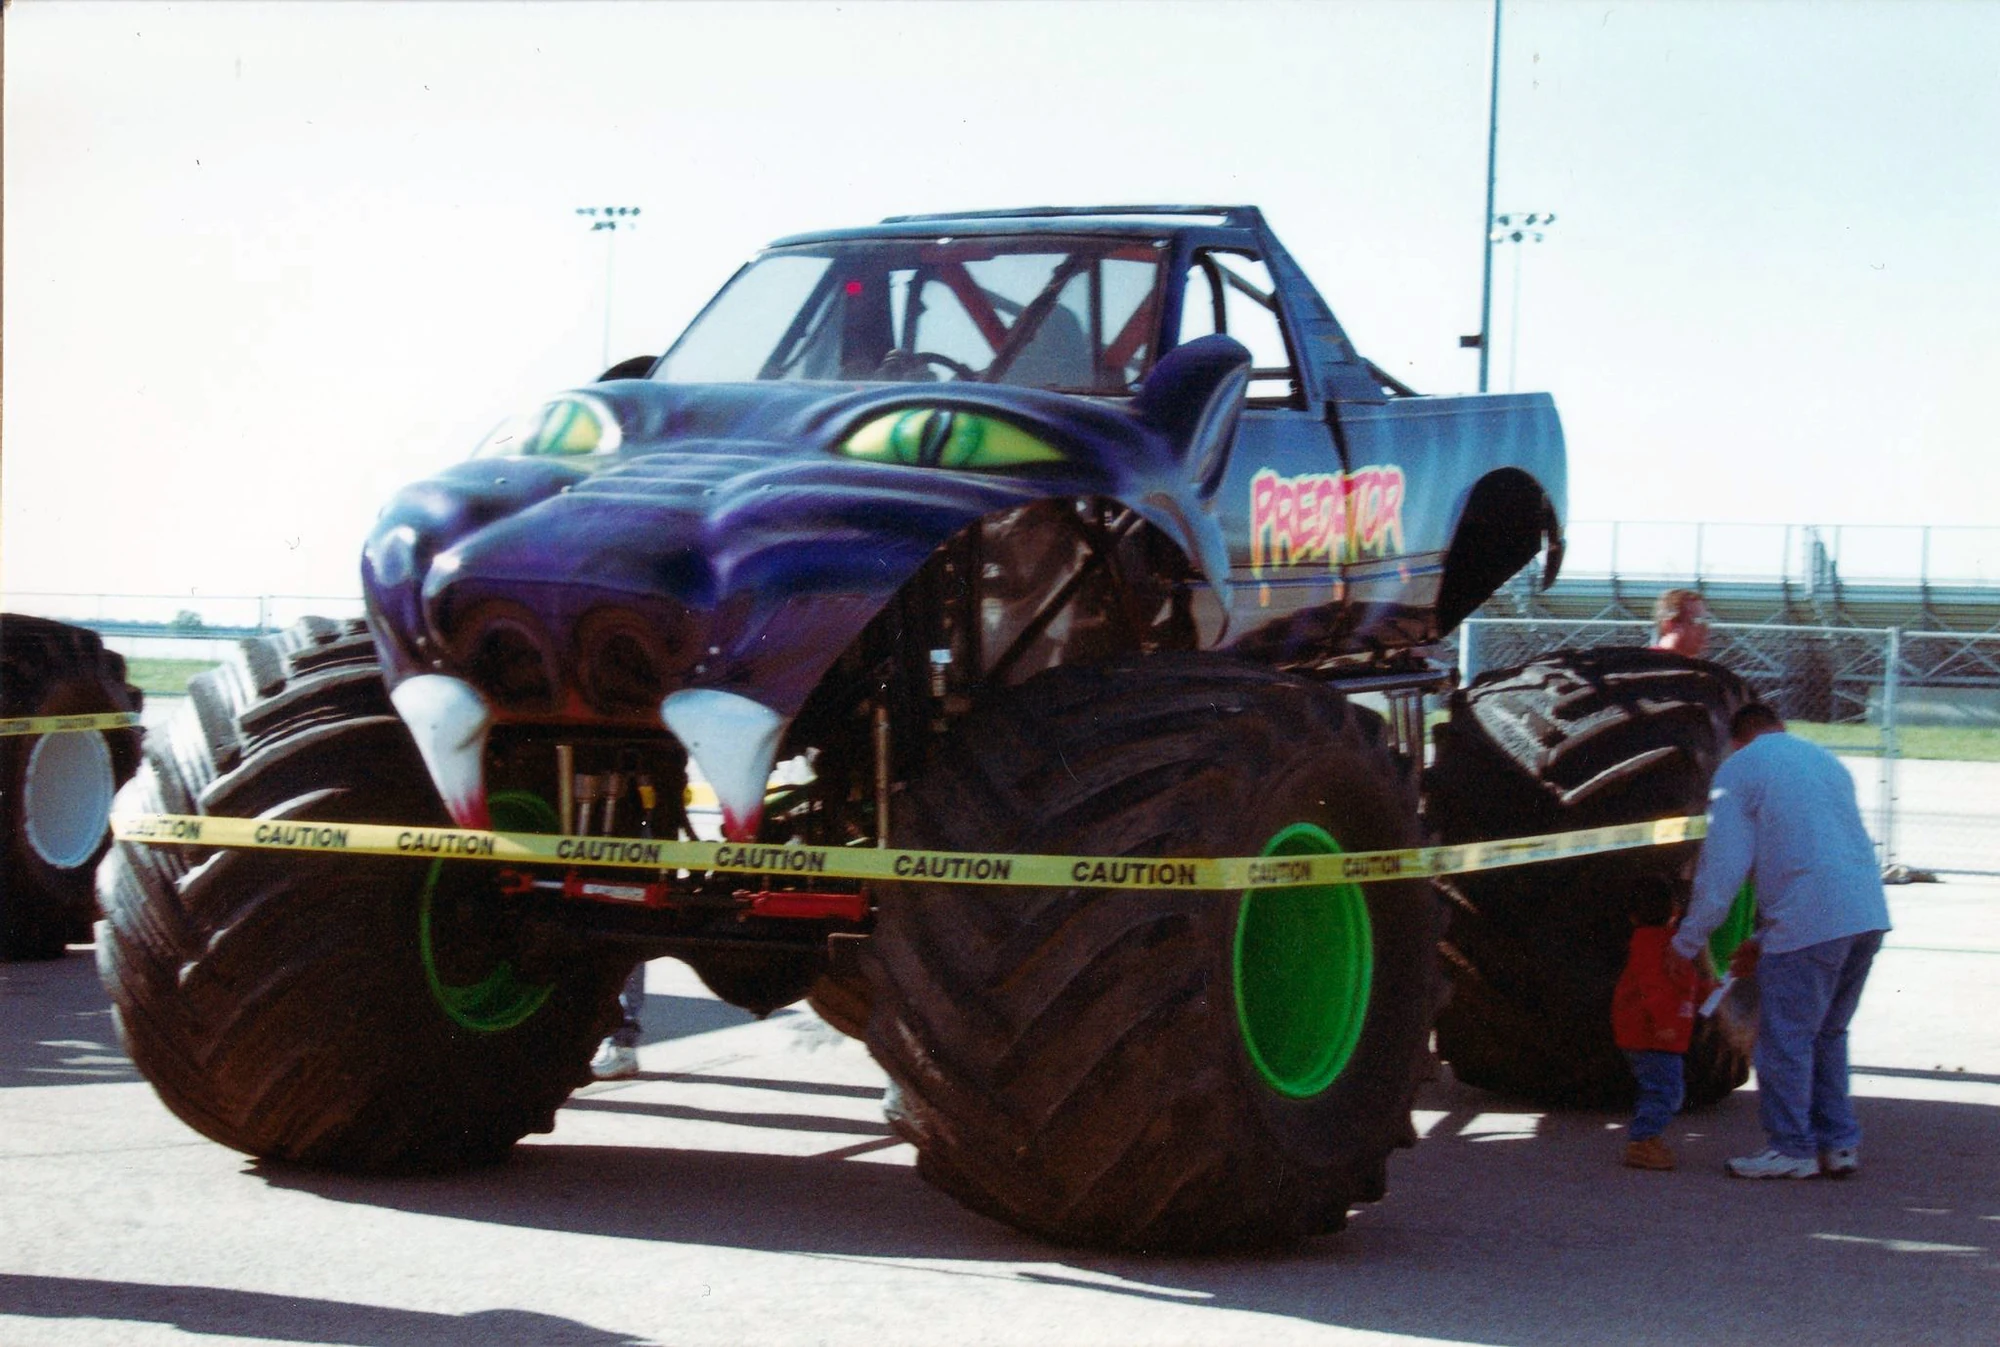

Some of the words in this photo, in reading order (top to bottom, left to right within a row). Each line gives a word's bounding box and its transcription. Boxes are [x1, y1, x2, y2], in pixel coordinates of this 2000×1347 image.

[1249, 465, 1405, 576] PREDATOR
[254, 824, 348, 848] CAUTION
[396, 832, 494, 856] CAUTION
[556, 839, 661, 863] CAUTION
[715, 846, 827, 872] CAUTION
[894, 854, 1013, 880] CAUTION
[1072, 861, 1196, 885] CAUTION
[1248, 861, 1311, 884] CAUTION
[1342, 854, 1403, 878] CAUTION
